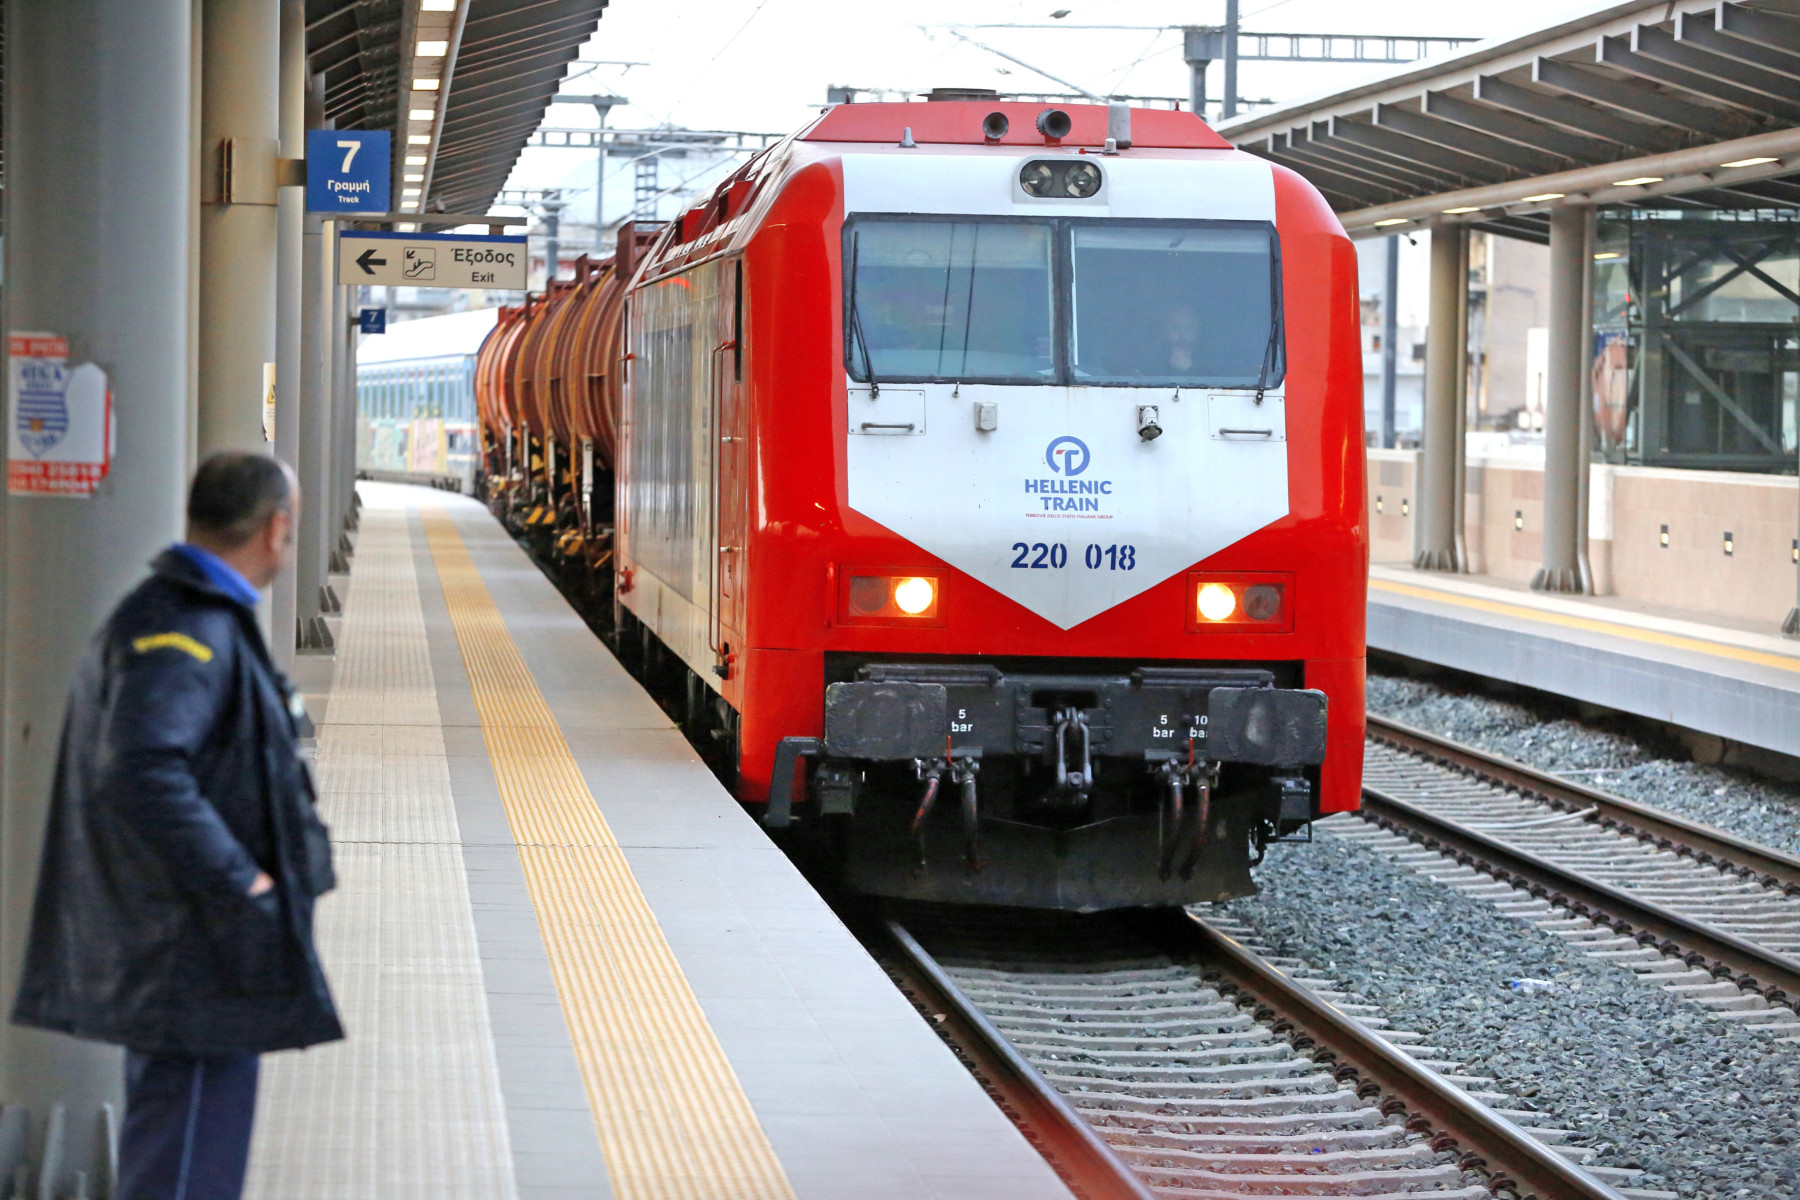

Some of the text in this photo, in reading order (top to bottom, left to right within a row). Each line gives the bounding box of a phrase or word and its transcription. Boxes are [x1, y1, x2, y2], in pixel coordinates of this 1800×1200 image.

[336, 140, 361, 173] 7
[327, 179, 370, 192] Γραμμή
[337, 195, 359, 203] Track
[450, 247, 515, 266] Έξοδος
[471, 271, 495, 282] Exit
[368, 310, 378, 322] 7
[1024, 479, 1112, 494] HELLENIC
[1040, 496, 1098, 511] TRAIN
[1010, 542, 1136, 571] 220 018
[958, 708, 966, 719] 5
[1160, 714, 1208, 725] 5 10
[951, 721, 973, 732] bar
[1152, 726, 1174, 737] bar
